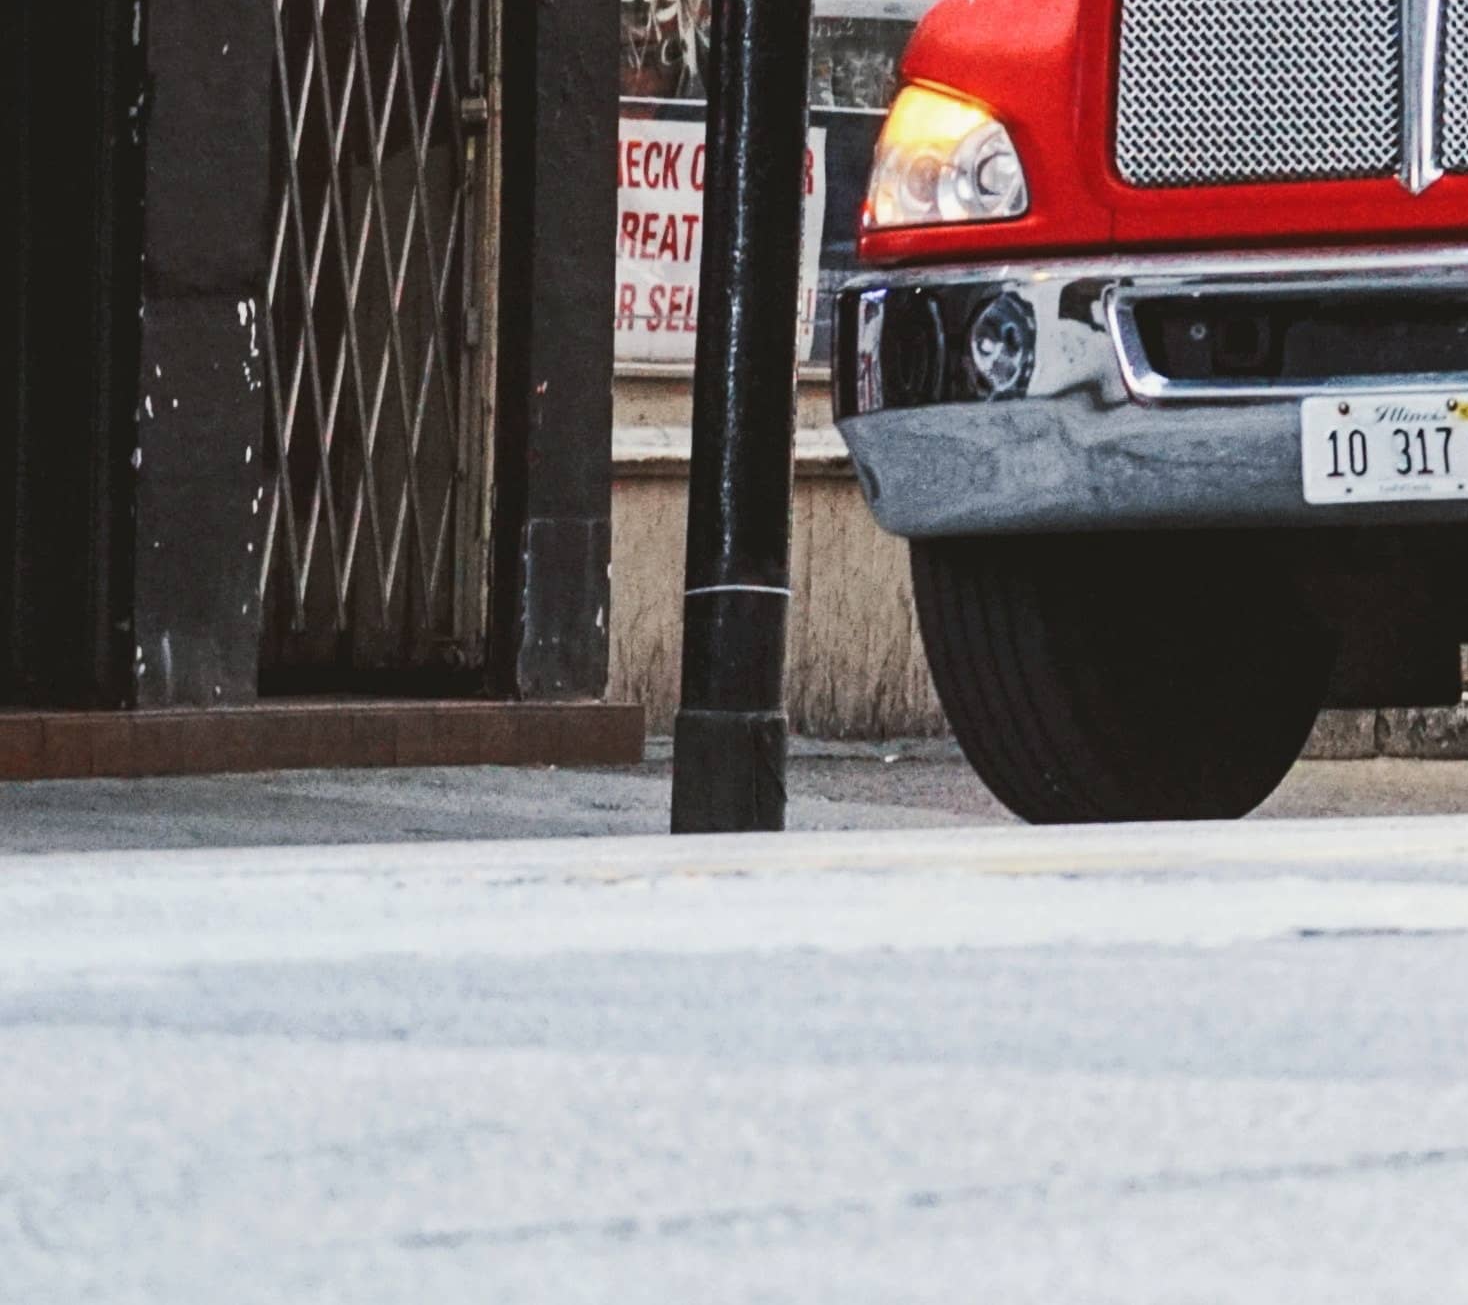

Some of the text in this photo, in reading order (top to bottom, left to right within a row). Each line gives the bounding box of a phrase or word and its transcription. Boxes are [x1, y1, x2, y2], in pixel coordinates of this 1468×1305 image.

[621, 211, 699, 262] REAT
[647, 284, 696, 332] SEL
[1326, 428, 1368, 478] 10
[1393, 426, 1453, 476] 317
